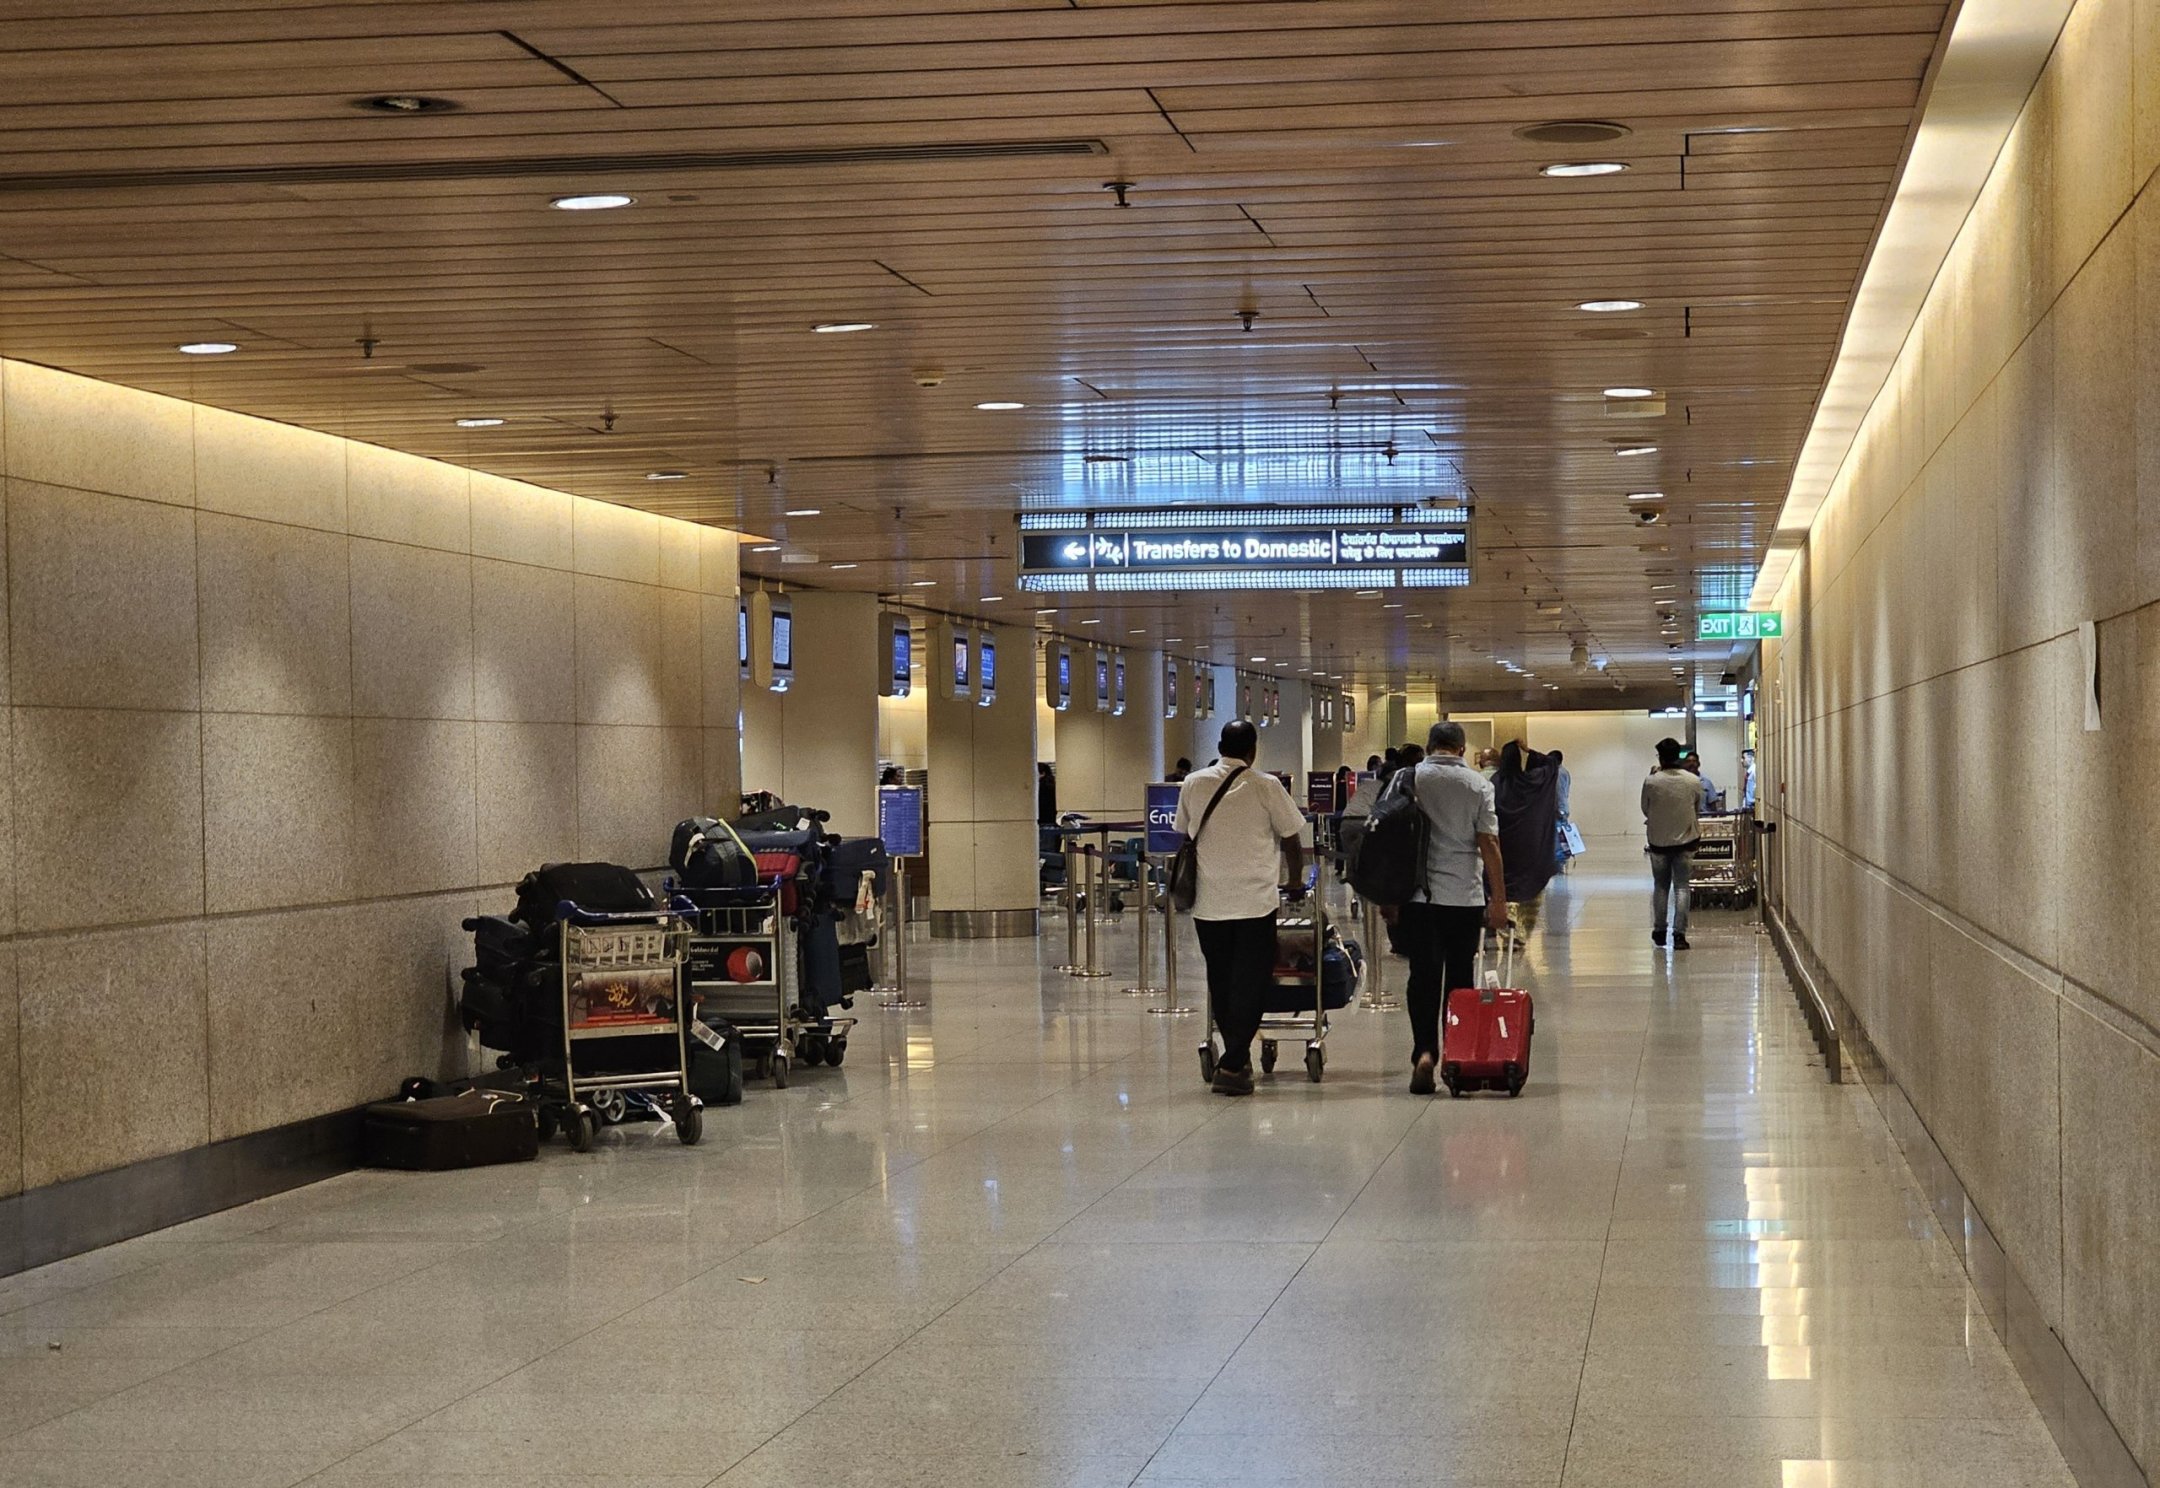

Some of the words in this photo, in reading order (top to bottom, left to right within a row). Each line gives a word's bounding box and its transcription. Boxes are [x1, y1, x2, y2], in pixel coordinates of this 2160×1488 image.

[1133, 539, 1219, 559] Transfers
[1222, 539, 1241, 558] to
[1244, 538, 1331, 559] Domestic
[1701, 619, 1730, 634] EXIT
[1149, 809, 1177, 825] Ent
